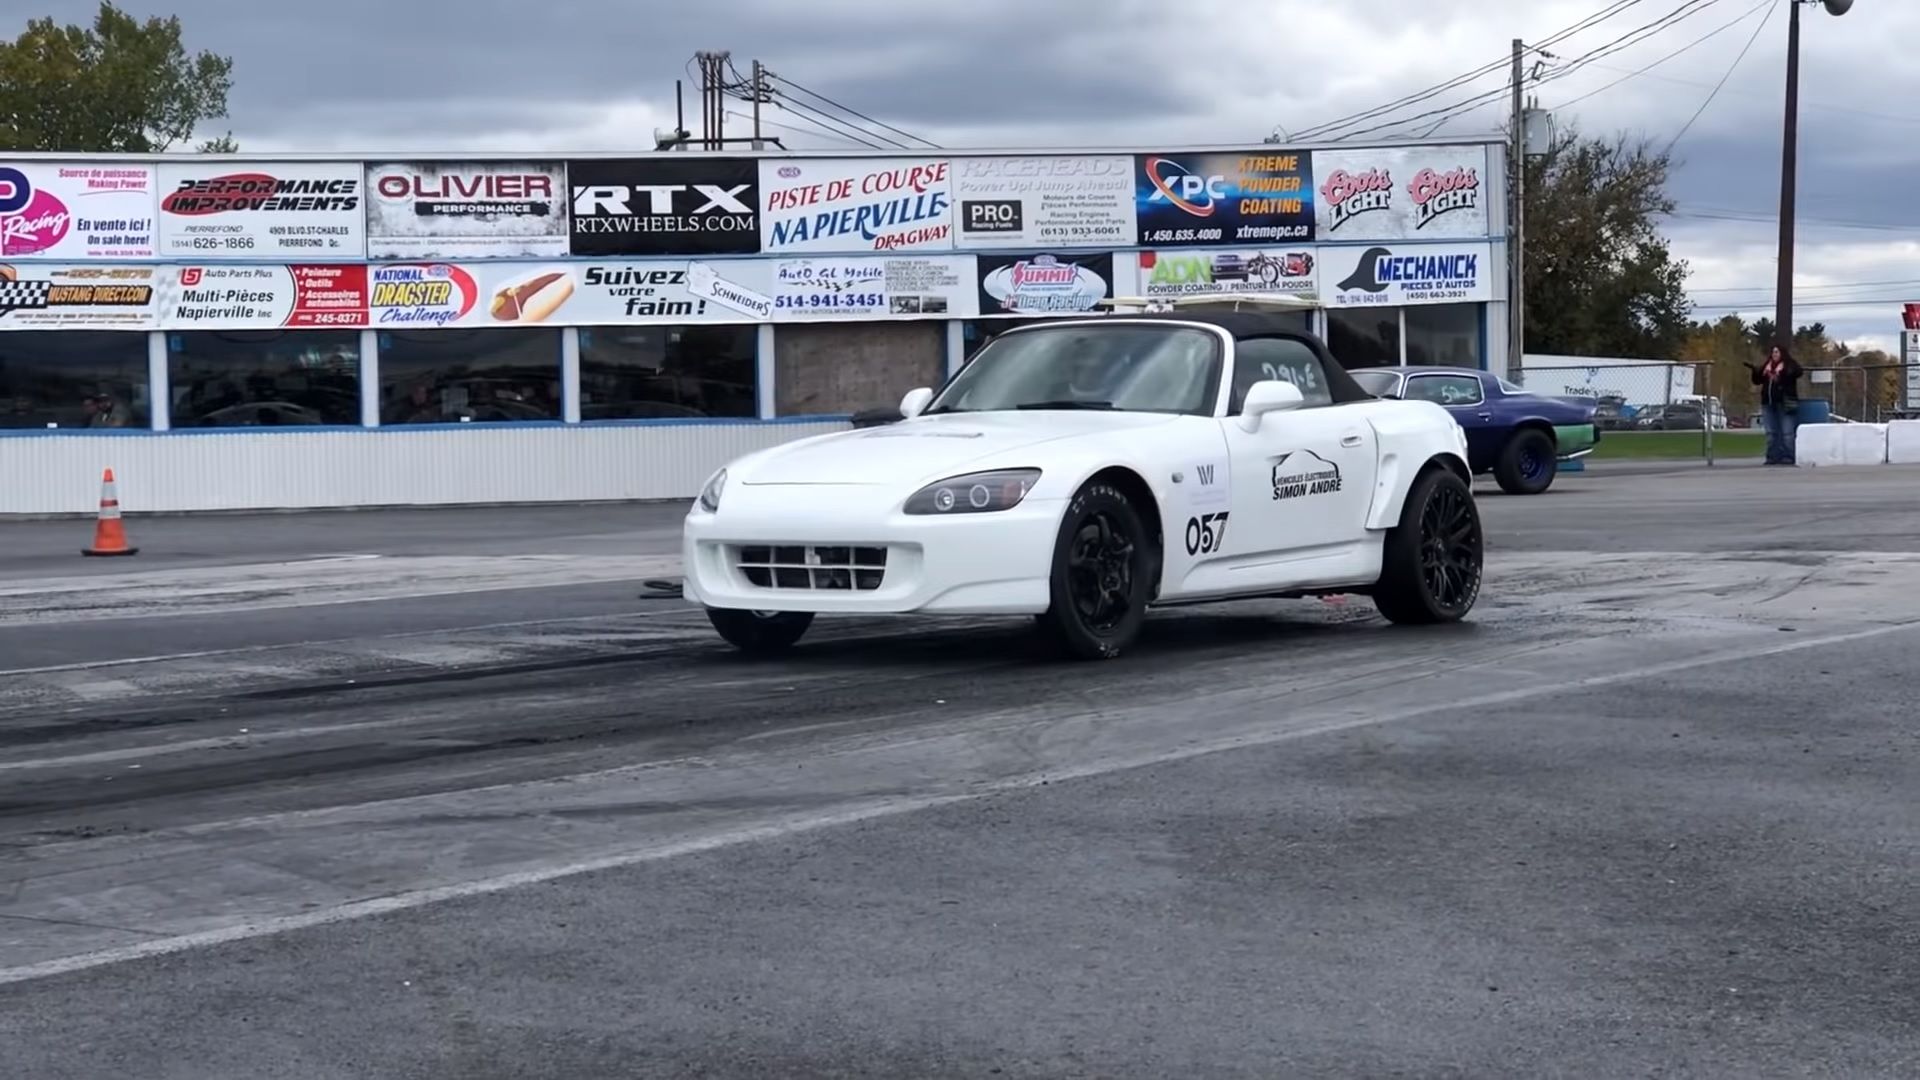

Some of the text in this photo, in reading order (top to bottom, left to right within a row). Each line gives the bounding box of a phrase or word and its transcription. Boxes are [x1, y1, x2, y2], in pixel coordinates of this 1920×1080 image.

[961, 158, 1129, 178] RACEHEADS
[1238, 156, 1298, 172] XTREME
[59, 168, 147, 179] Source de puissance
[88, 179, 147, 190] Making Power
[177, 179, 358, 194] PERFORMANCE
[378, 175, 552, 198] OLIVIER
[767, 162, 949, 212] PISTE DE COURSE
[960, 181, 1005, 192] Power
[1034, 180, 1075, 193] Jump
[1149, 175, 1226, 201] XPC
[1238, 177, 1301, 193] POWDER
[1319, 166, 1393, 206] Coors
[1406, 165, 1480, 205] Coors
[170, 196, 359, 211] IMPROVEMENTS
[573, 184, 754, 215] RTX
[1240, 199, 1302, 215] COATING
[433, 204, 531, 213] PERFORMANCE
[971, 204, 1013, 222] PRO
[1050, 211, 1077, 219] Racing
[1329, 189, 1392, 231] LIGHT
[1416, 188, 1478, 230] LIGHT
[3, 209, 70, 245] Racing
[77, 219, 90, 231] En
[93, 219, 127, 231] vente
[129, 218, 145, 231] ici
[575, 215, 755, 233] RTXWHEELS.COM
[769, 192, 949, 247] NAPIERVILLE
[971, 222, 995, 230] Racing
[1035, 219, 1084, 227] Performance
[184, 225, 244, 233] PIERREFOND
[269, 226, 287, 235] 4909
[874, 223, 951, 250] DRAGWAY
[1040, 226, 1121, 237] (613) 933-6061
[1143, 225, 1309, 242] 1.450.635.4000 xtremepc.ca
[87, 234, 150, 245] On sale here!
[193, 237, 255, 250] 626-1866
[279, 238, 323, 247] PIERREFOND
[204, 269, 273, 278] Auto Parts Plus
[302, 268, 342, 277] Peinture
[843, 266, 884, 279] Mobile
[1150, 255, 1211, 284] ADN
[1378, 254, 1477, 281] MECHANICK
[305, 278, 333, 288] Outils
[374, 270, 424, 281] NATIONAL
[584, 266, 685, 285] Suivez
[609, 286, 655, 297] votre
[1147, 284, 1183, 294] POWDER
[1184, 282, 1223, 292] COATING
[1230, 281, 1267, 291] PEINTURE
[1269, 280, 1281, 289] EN
[1400, 280, 1476, 291] PIECES D'AUTOS
[182, 289, 274, 302] Multi-Pièces
[305, 290, 360, 299] Accessoires
[371, 281, 452, 307] DRAGSTER
[775, 293, 885, 308] 514-941-3451
[1049, 292, 1093, 311] Racing
[1429, 290, 1467, 298] 663-3921
[305, 299, 361, 308] automobiles
[625, 297, 692, 316] faim
[176, 305, 254, 321] Napierville
[314, 313, 362, 323] 245-0371
[380, 308, 458, 326] Challenge
[1272, 482, 1306, 500] SIMON
[1185, 511, 1230, 556] 057
